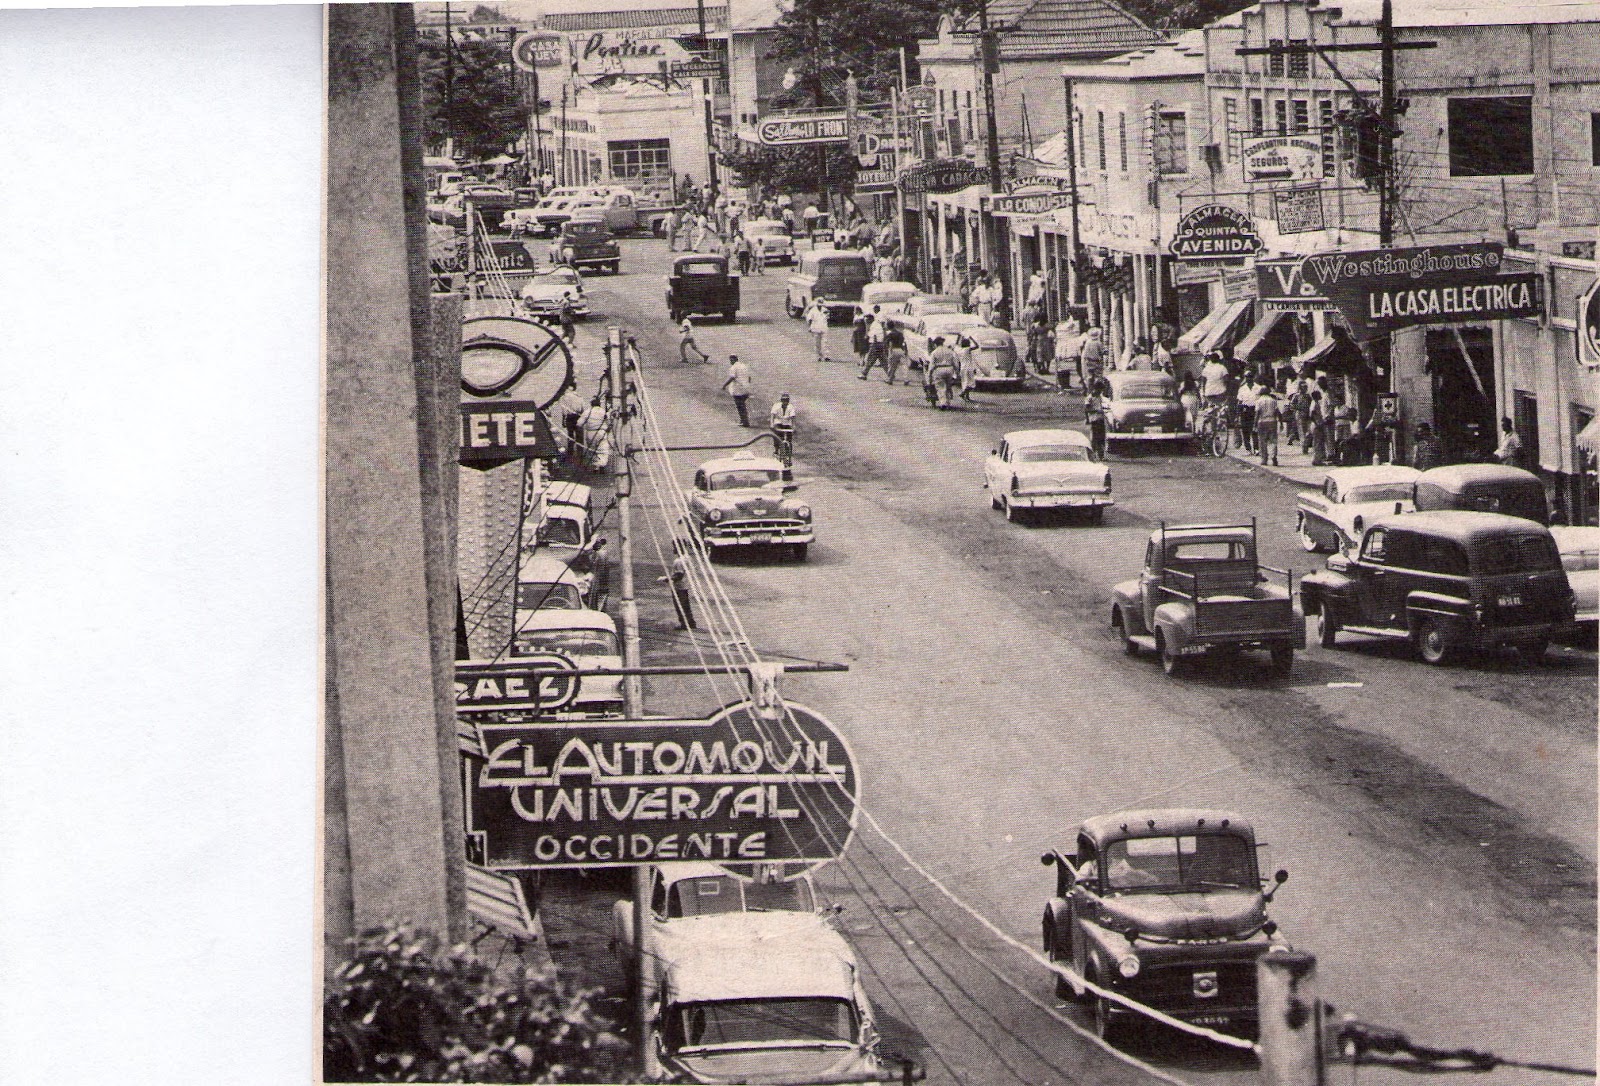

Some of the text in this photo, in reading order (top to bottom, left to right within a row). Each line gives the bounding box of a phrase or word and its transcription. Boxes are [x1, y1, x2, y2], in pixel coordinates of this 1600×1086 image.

[527, 50, 561, 61] NUEV
[583, 32, 666, 60] Pontiac
[818, 120, 848, 136] FRONT
[1251, 156, 1289, 168] SEGUROS
[1188, 206, 1246, 229] ALMACEN
[1196, 226, 1238, 238] QUINTA
[1181, 239, 1254, 254] AVENIDA
[1309, 249, 1499, 285] Westinghouse
[1370, 282, 1531, 319] LA CASA ELECTRICA
[510, 786, 800, 822] UNIVERSAL
[534, 832, 766, 861] OCCIDENTE
